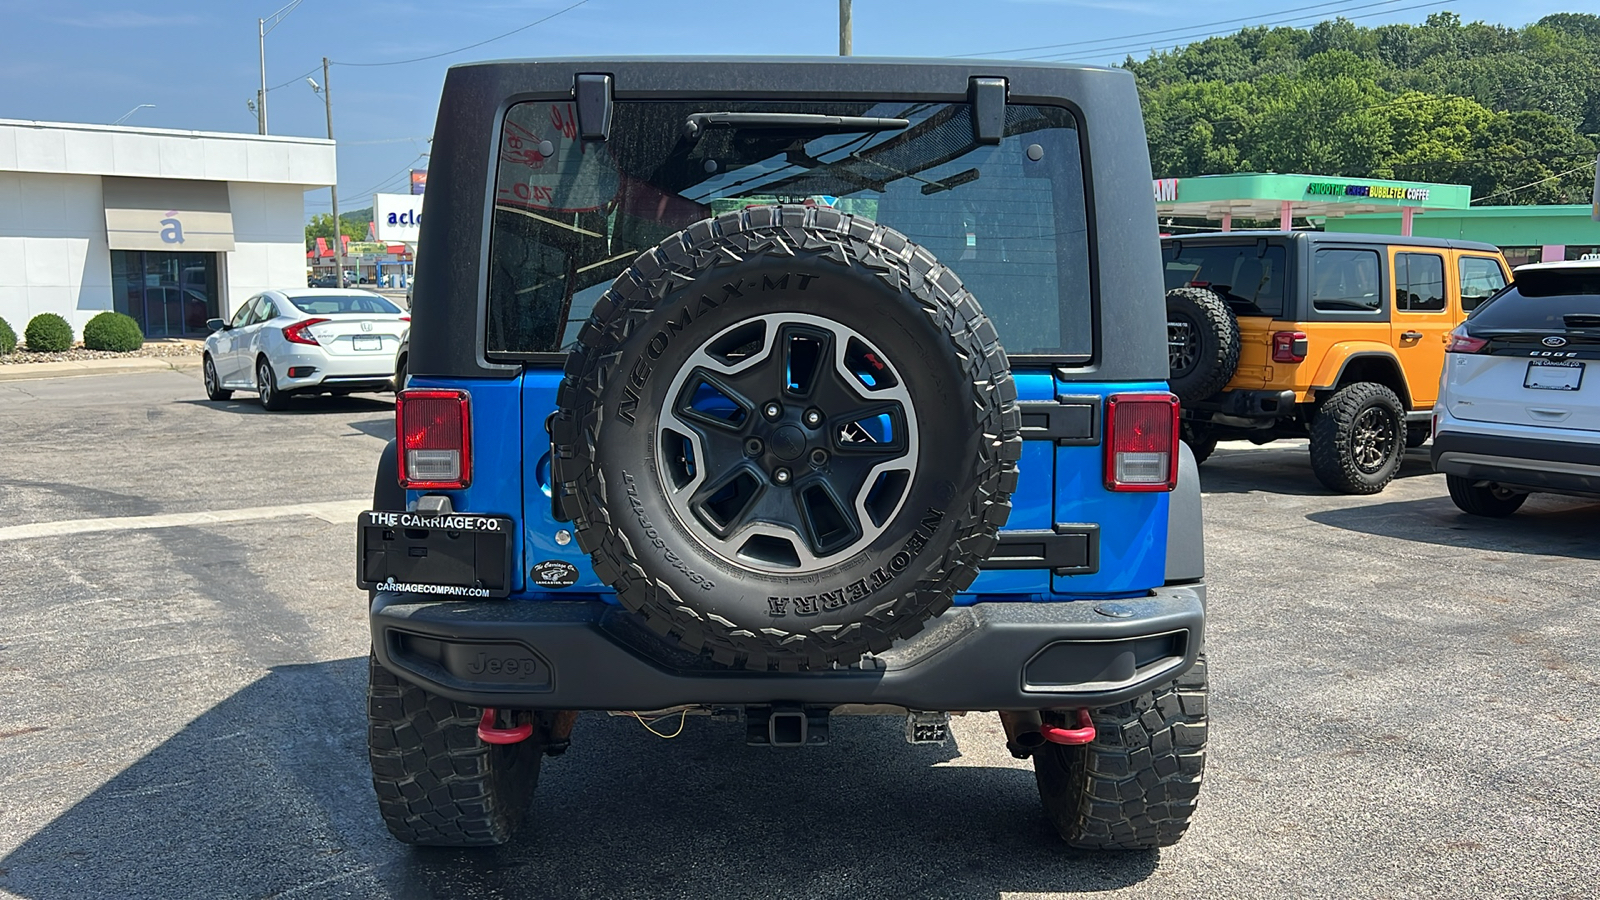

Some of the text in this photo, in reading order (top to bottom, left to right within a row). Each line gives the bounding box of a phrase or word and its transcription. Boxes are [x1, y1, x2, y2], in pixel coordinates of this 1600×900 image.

[1308, 183, 1346, 195] SMOOTHIE
[1406, 188, 1430, 200] COFFEE
[369, 512, 501, 531] THE CARRIAGE CO.
[767, 506, 946, 618] NEOTERRA
[376, 582, 490, 598] CARRIAGECOMPANY.COM
[467, 652, 537, 680] Jeep
